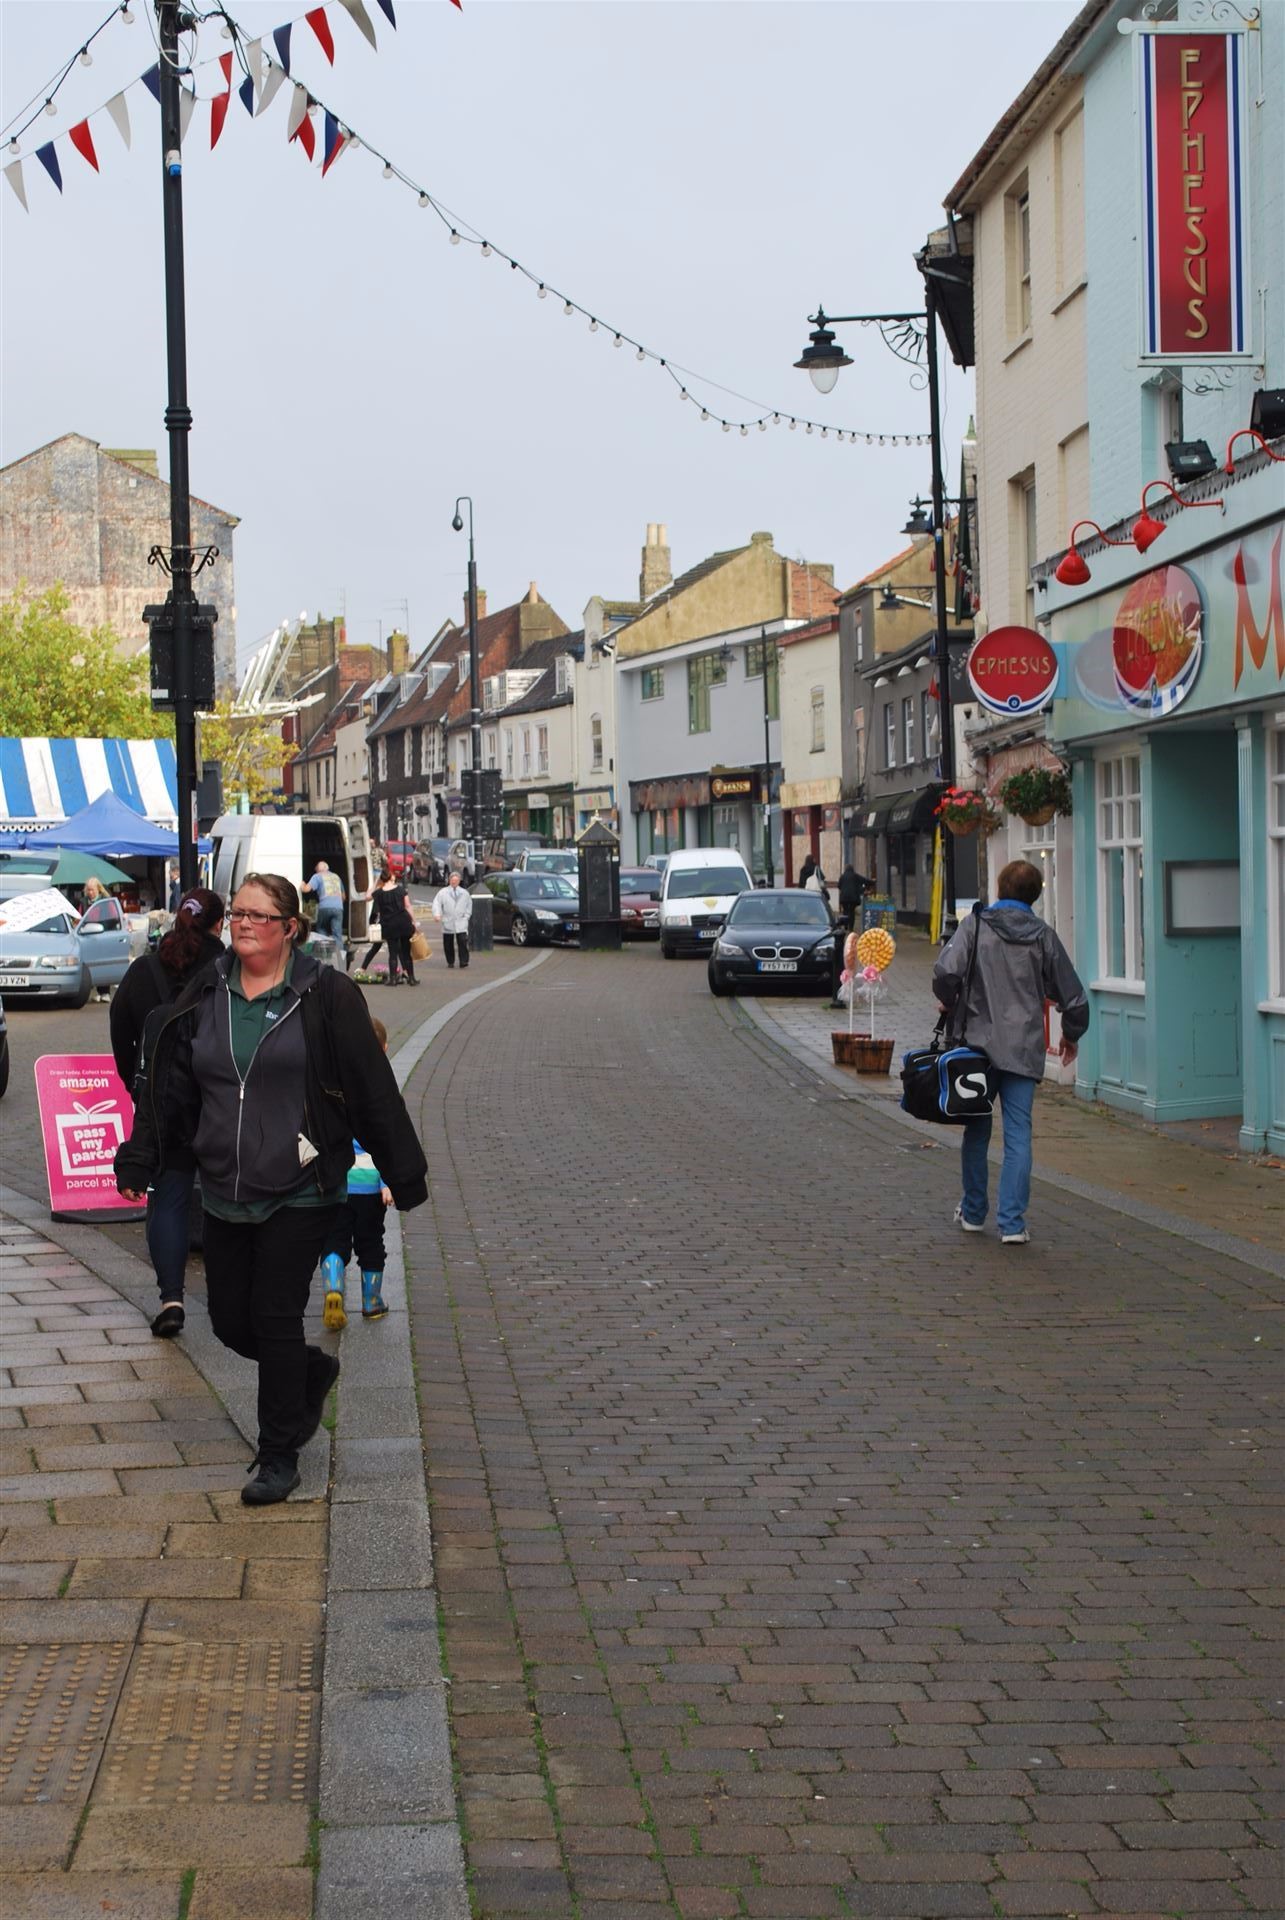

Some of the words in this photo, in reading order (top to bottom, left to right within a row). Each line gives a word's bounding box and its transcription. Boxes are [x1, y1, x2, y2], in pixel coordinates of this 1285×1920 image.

[1180, 48, 1209, 339] EPHESUS
[976, 656, 1051, 675] EPHESUS
[60, 1078, 109, 1088] amazon
[73, 1127, 106, 1142] pass
[80, 1139, 103, 1150] my
[66, 1177, 99, 1190] parcel
